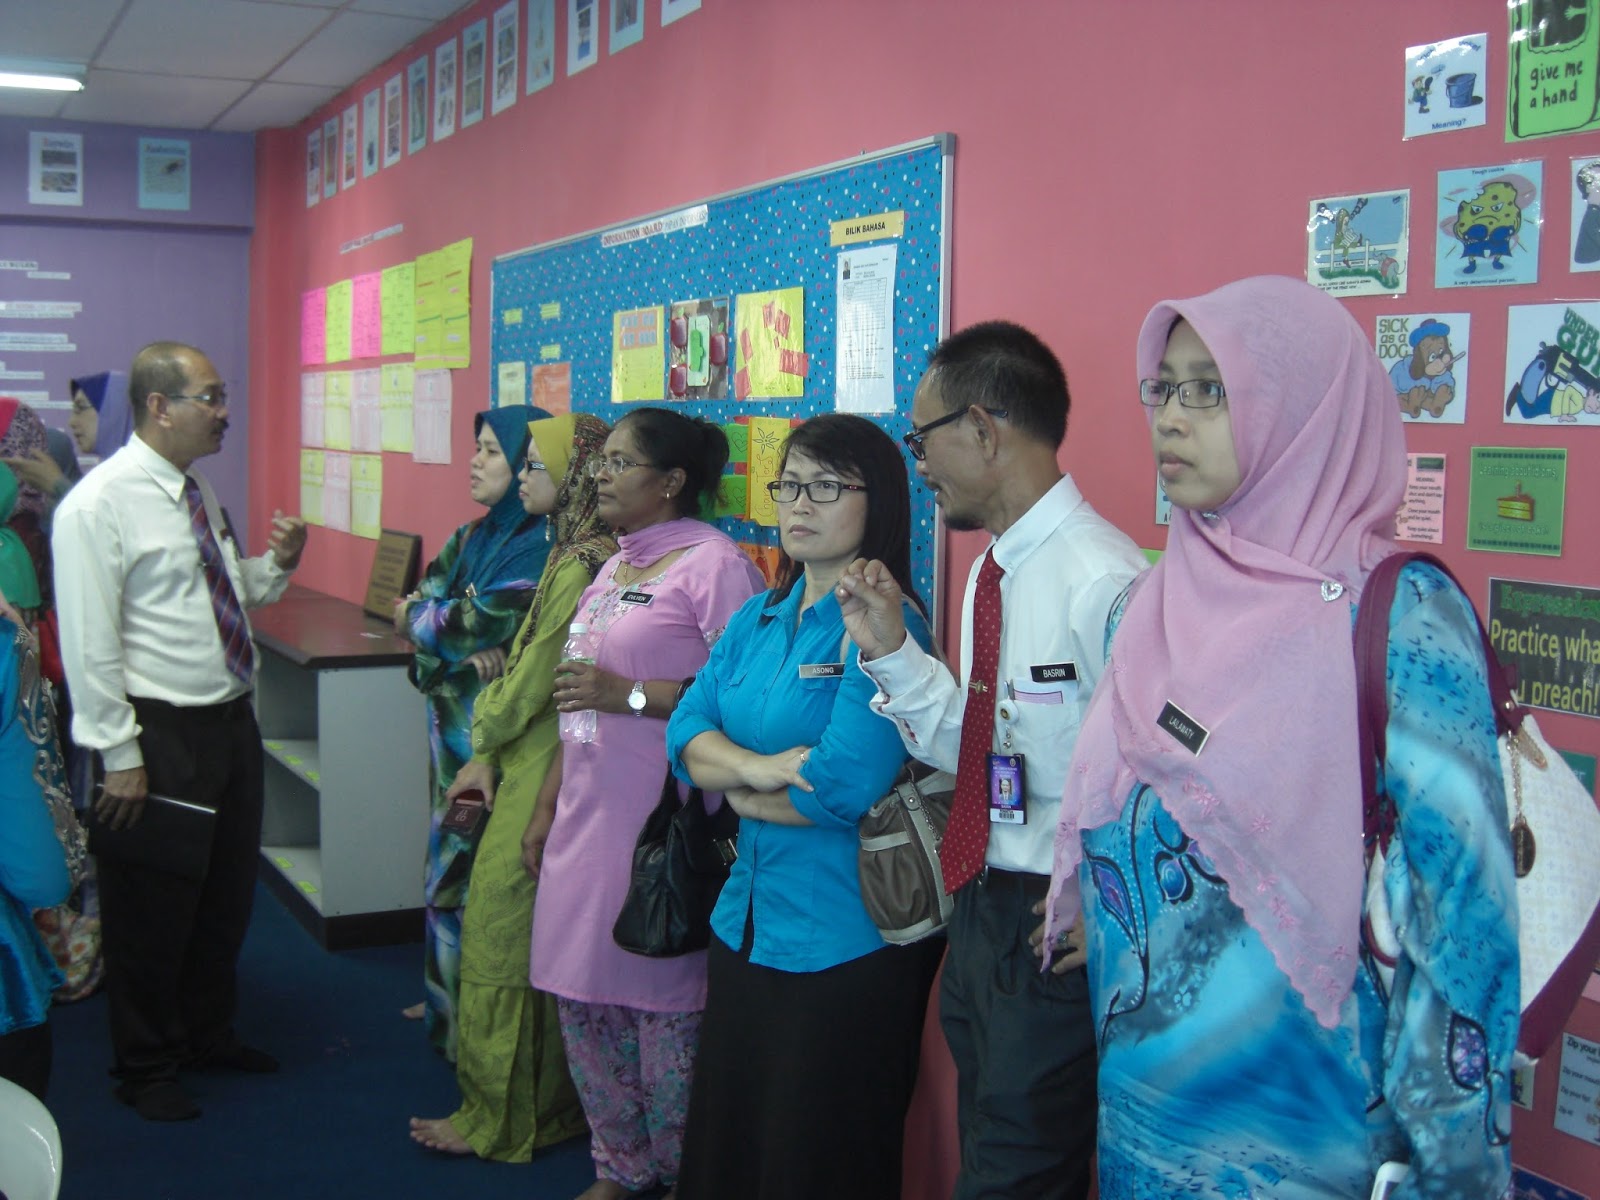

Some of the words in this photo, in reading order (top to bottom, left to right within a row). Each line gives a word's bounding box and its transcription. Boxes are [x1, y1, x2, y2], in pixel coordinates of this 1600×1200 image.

[1530, 62, 1559, 90] give
[1564, 60, 1583, 78] me
[1530, 97, 1537, 108] a
[1542, 79, 1578, 108] hand
[1431, 118, 1467, 130] Meaning?
[603, 228, 639, 246] INFORMATION
[845, 226, 861, 236] BILIK
[862, 221, 886, 233] BAHASA
[1379, 318, 1410, 334] SICK
[1380, 334, 1395, 344] as
[1398, 333, 1407, 344] a
[1379, 343, 1410, 359] DOG
[1490, 618, 1560, 659] Practice
[1531, 679, 1599, 715] preach!
[1567, 1036, 1579, 1049] Zip
[1580, 1043, 1597, 1055] your
